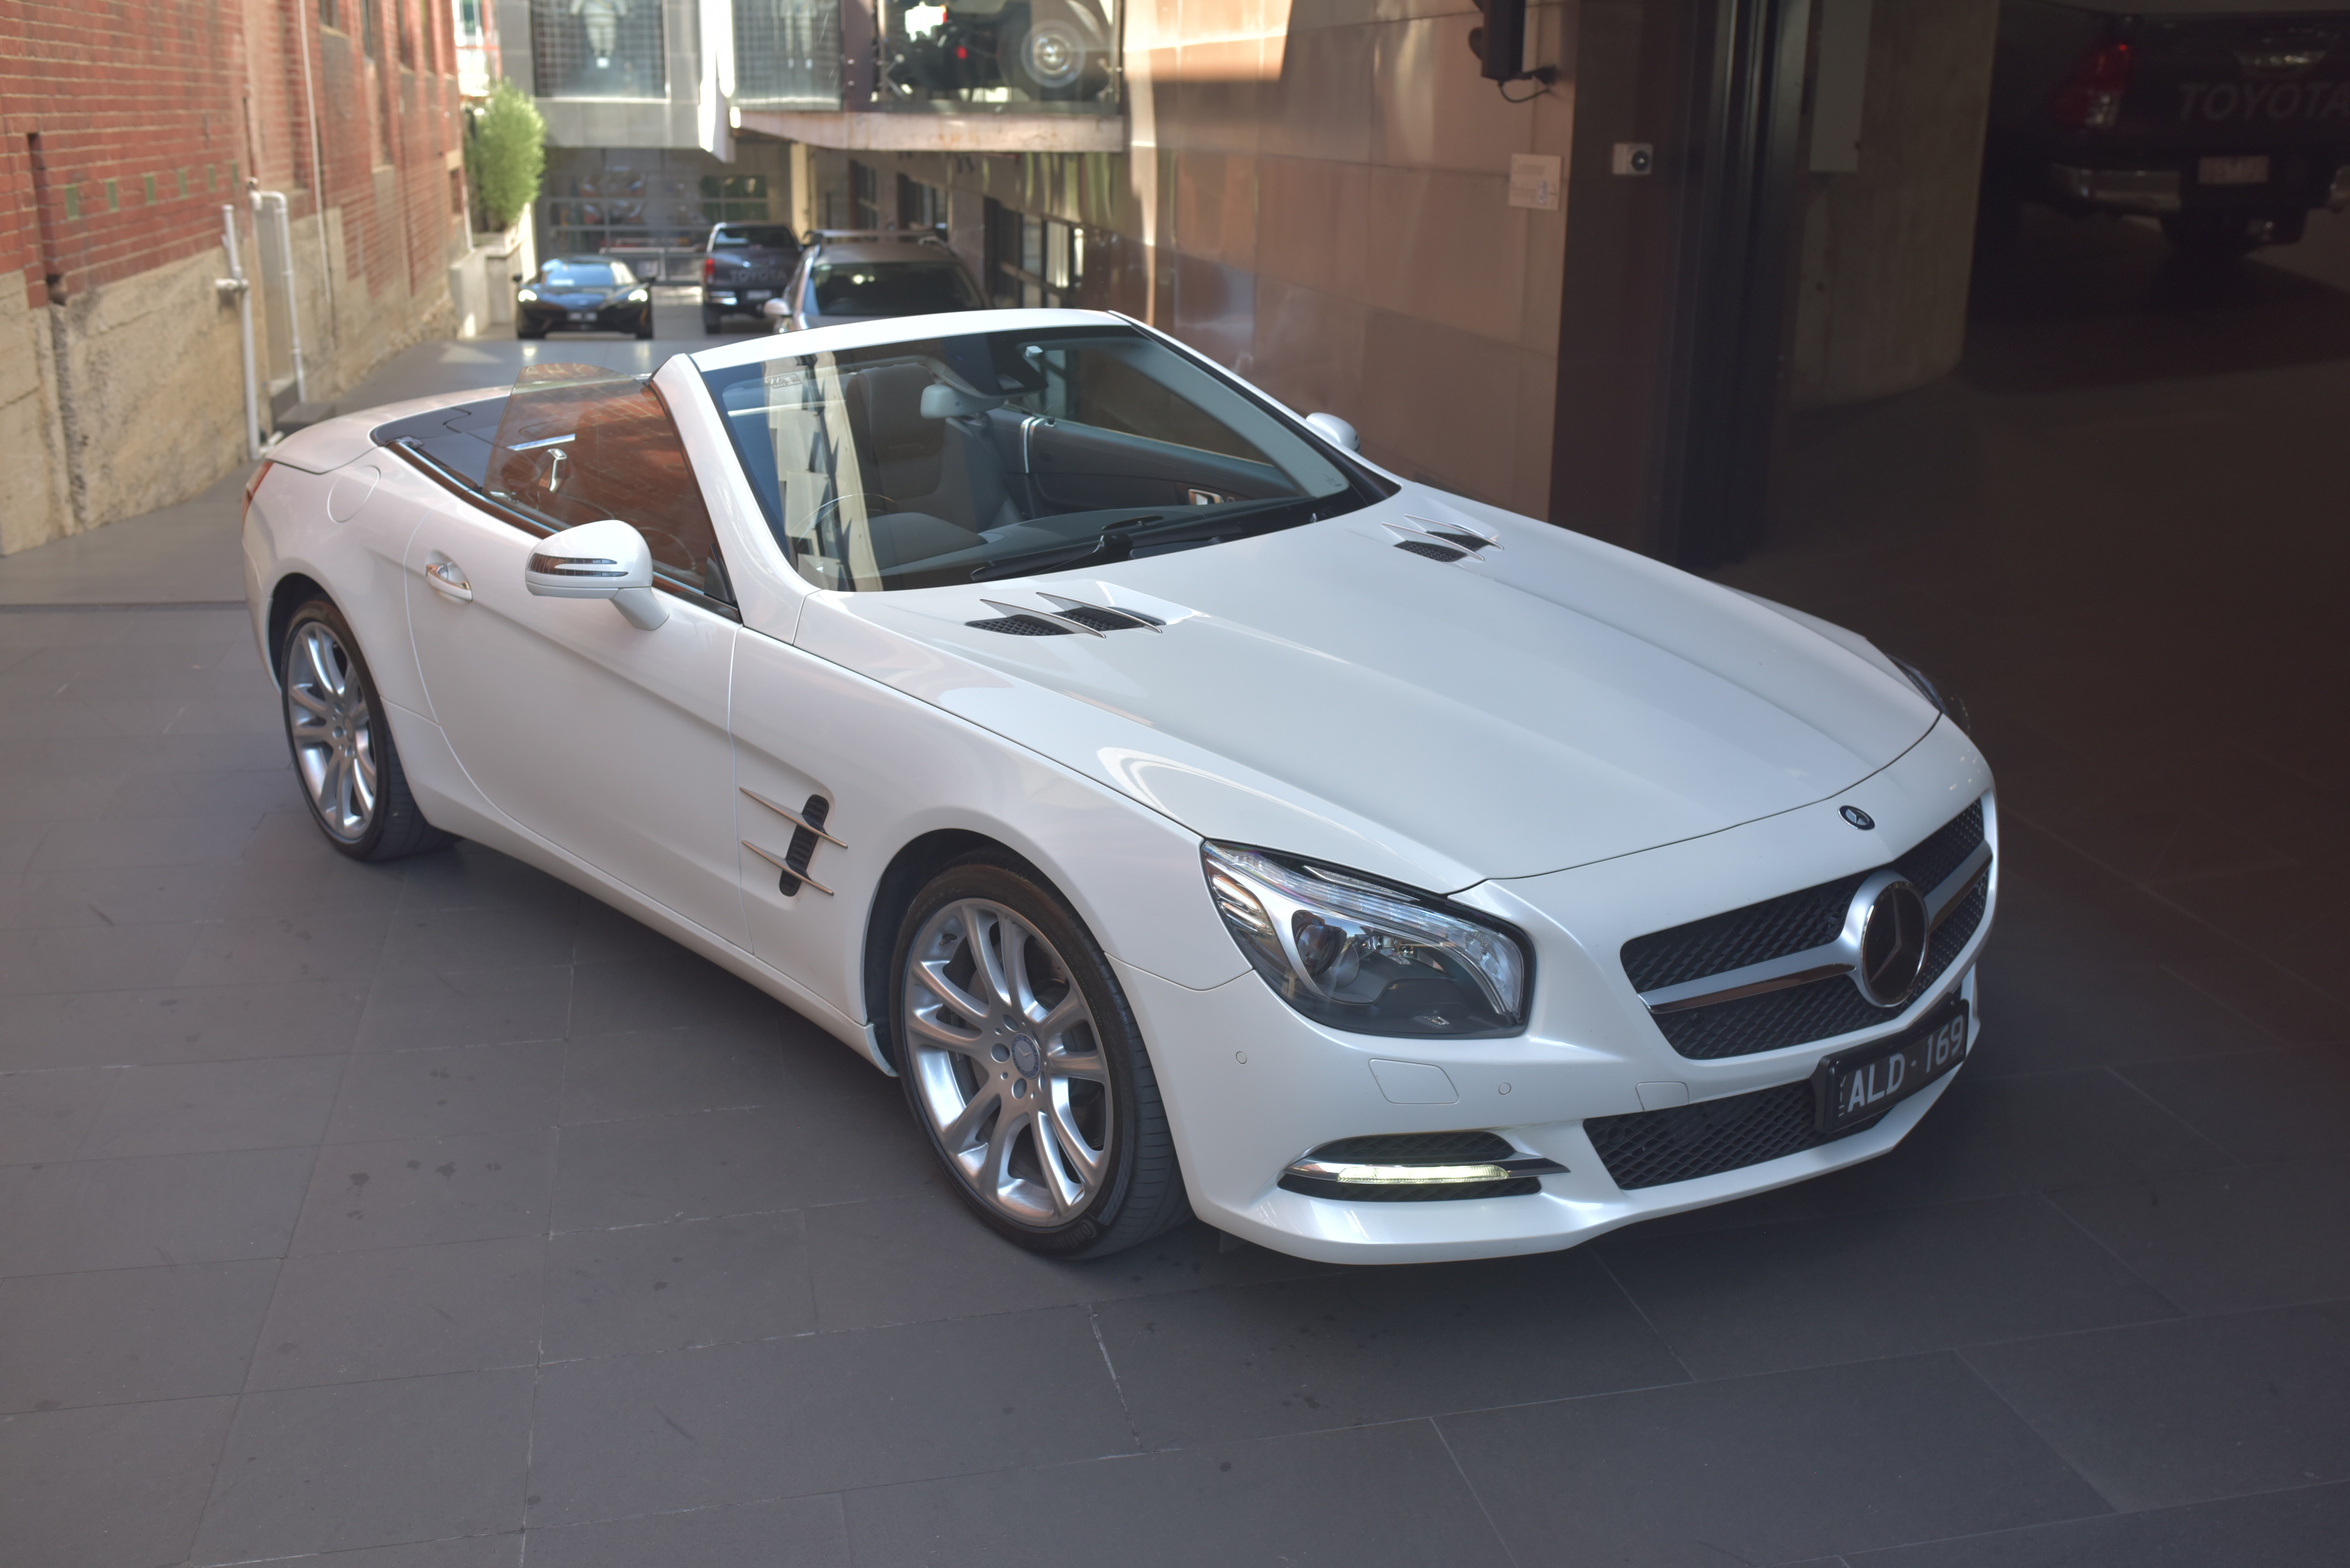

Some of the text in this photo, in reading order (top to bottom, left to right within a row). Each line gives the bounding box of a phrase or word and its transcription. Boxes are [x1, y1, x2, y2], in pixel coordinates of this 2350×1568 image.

[2178, 82, 2350, 120] TOYOTA
[1847, 1014, 1964, 1113] ALD 169
